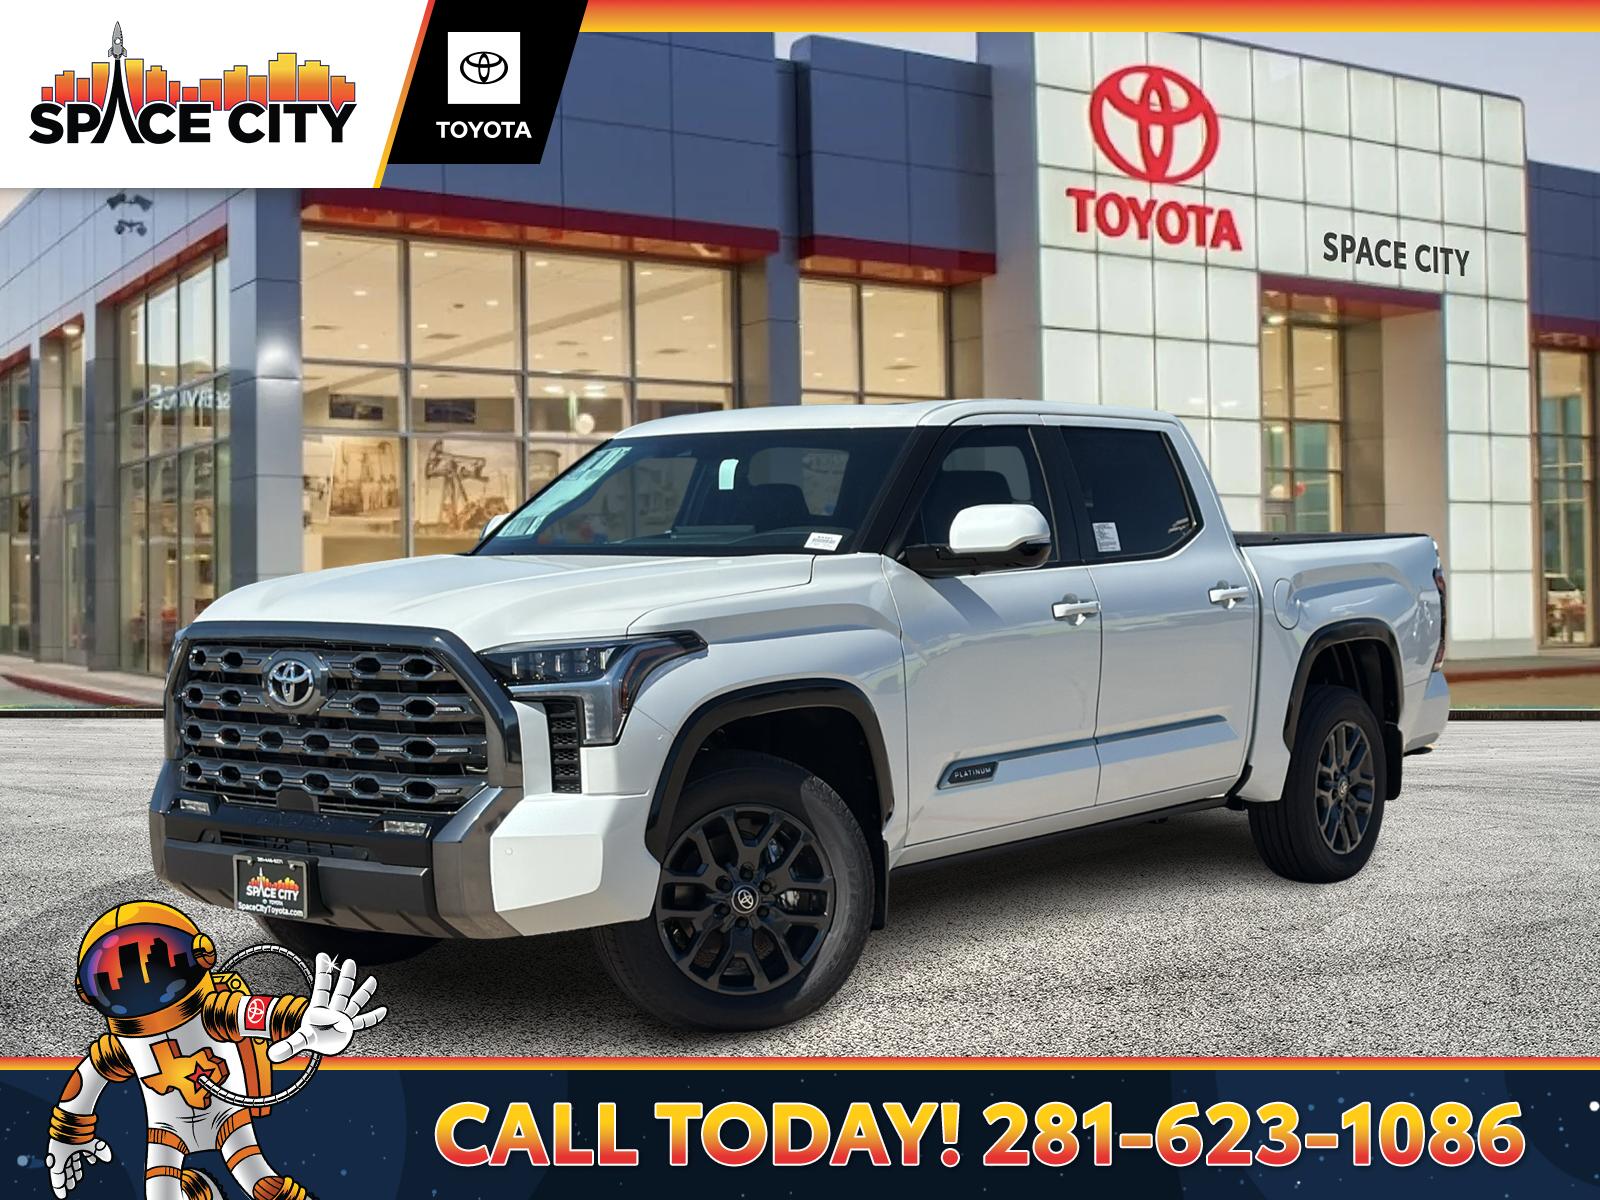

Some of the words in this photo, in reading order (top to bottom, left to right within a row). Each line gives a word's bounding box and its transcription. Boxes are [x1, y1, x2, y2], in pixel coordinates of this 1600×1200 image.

[1066, 187, 1242, 251] TOYOTA
[1323, 232, 1407, 270] SPACE
[1415, 244, 1470, 277] CITY
[954, 767, 991, 778] PLATINUM
[246, 880, 277, 898] SPACE
[278, 889, 299, 901] CITY
[238, 902, 303, 917] SpaceCityToyota.com
